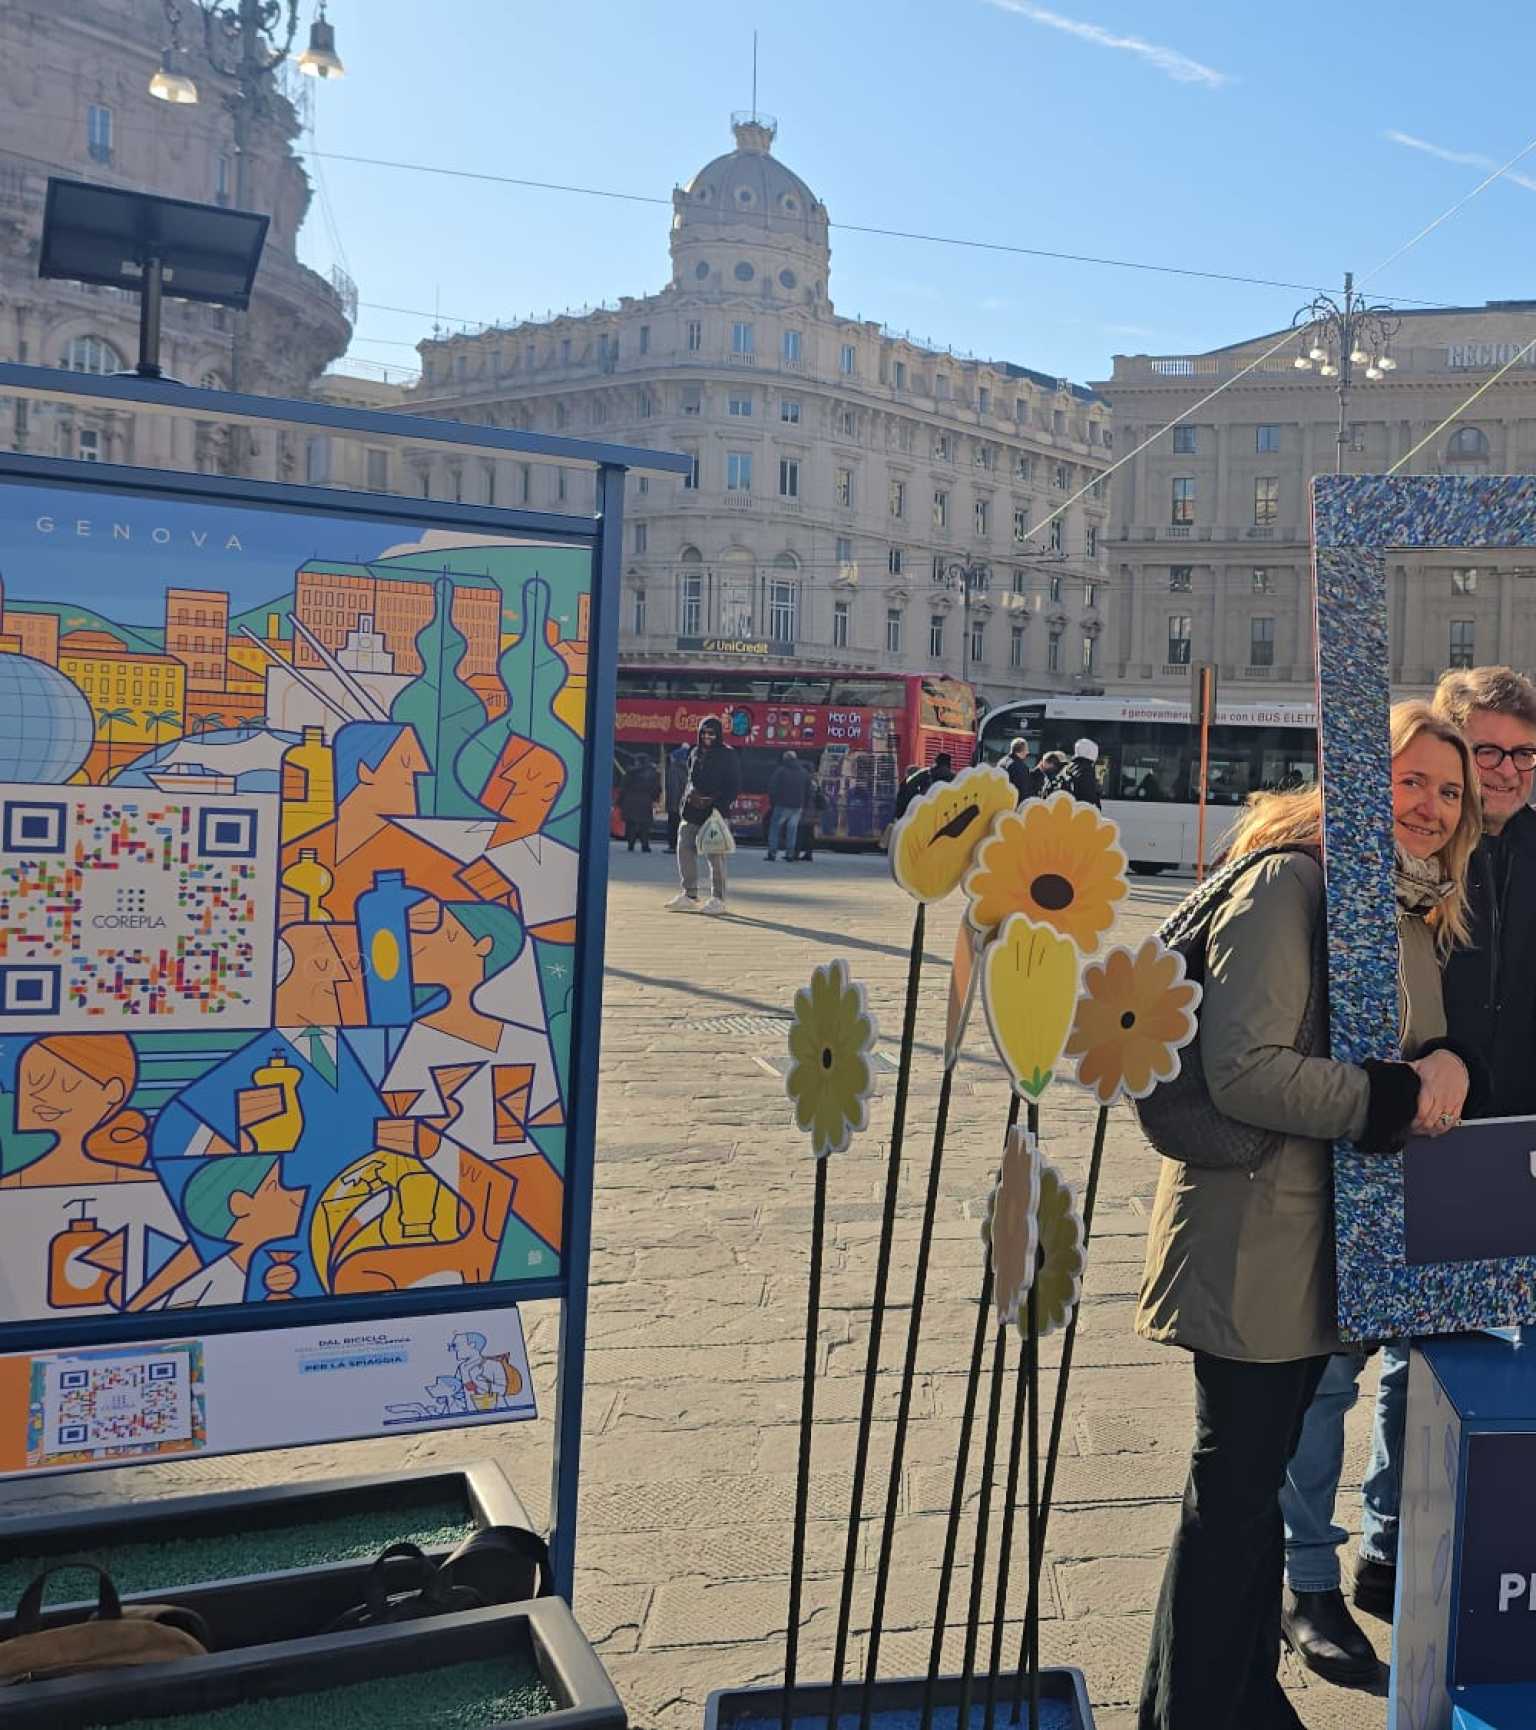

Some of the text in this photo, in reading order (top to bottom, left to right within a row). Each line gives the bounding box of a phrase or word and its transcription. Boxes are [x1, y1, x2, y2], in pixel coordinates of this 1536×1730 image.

[36, 516, 242, 551] GENOVA
[716, 640, 769, 653] UniCredit
[829, 712, 861, 723] Hop On
[1257, 713, 1280, 723] BUS
[828, 726, 861, 738] Hop Off
[92, 915, 166, 928] COREPLA
